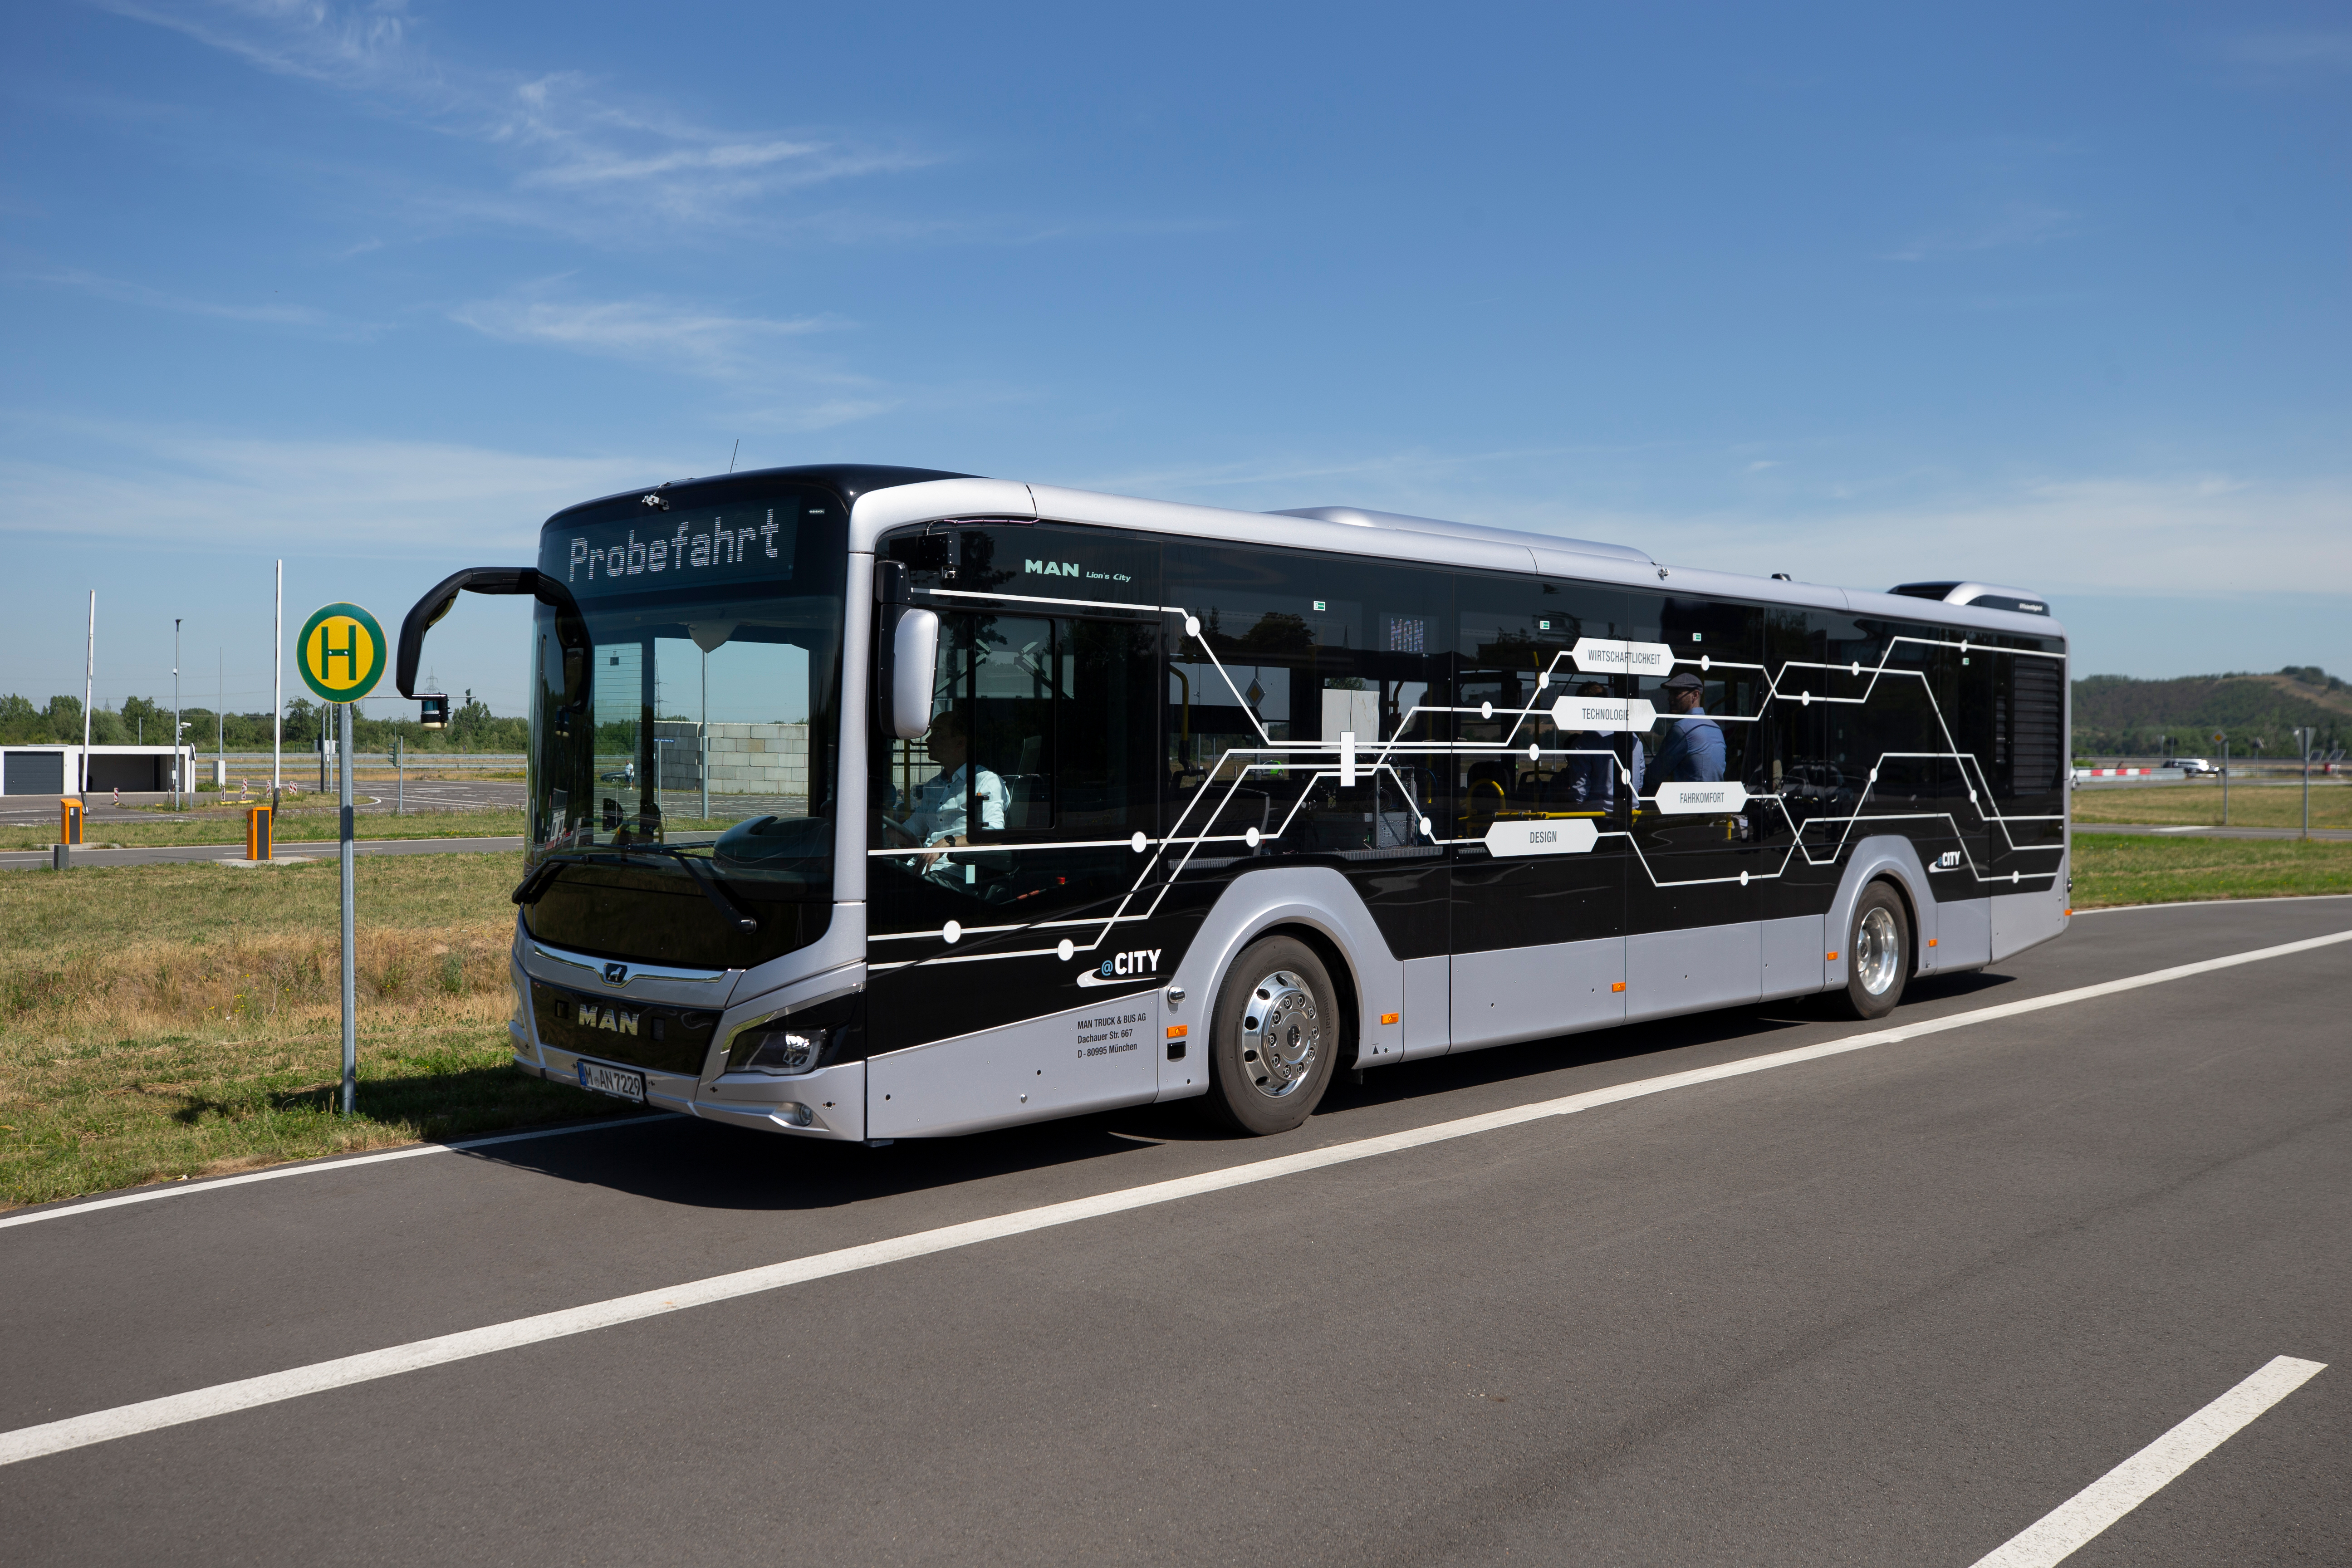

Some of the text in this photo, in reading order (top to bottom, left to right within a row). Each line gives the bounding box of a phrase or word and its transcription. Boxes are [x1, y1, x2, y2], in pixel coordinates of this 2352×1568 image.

[569, 509, 779, 582] Probefahrt
[1025, 559, 1131, 582] MAN Lion's City
[1391, 618, 1423, 652] MAN
[321, 625, 357, 681] H
[1588, 649, 1661, 665] WIRTSCHAFTLICHKEIT
[1583, 708, 1629, 720] TECHNOLOGIE
[1680, 792, 1725, 804] FAHRKOMFORT
[1530, 830, 1557, 843] DESIGN
[578, 1004, 639, 1035] MAN
[1078, 1013, 1146, 1029] MAN TRUCK & BUS AG
[1078, 1029, 1133, 1044] Dachauer Str. 667
[1109, 1043, 1137, 1054] München
[584, 1066, 593, 1085] M
[614, 1072, 641, 1096] 7229
